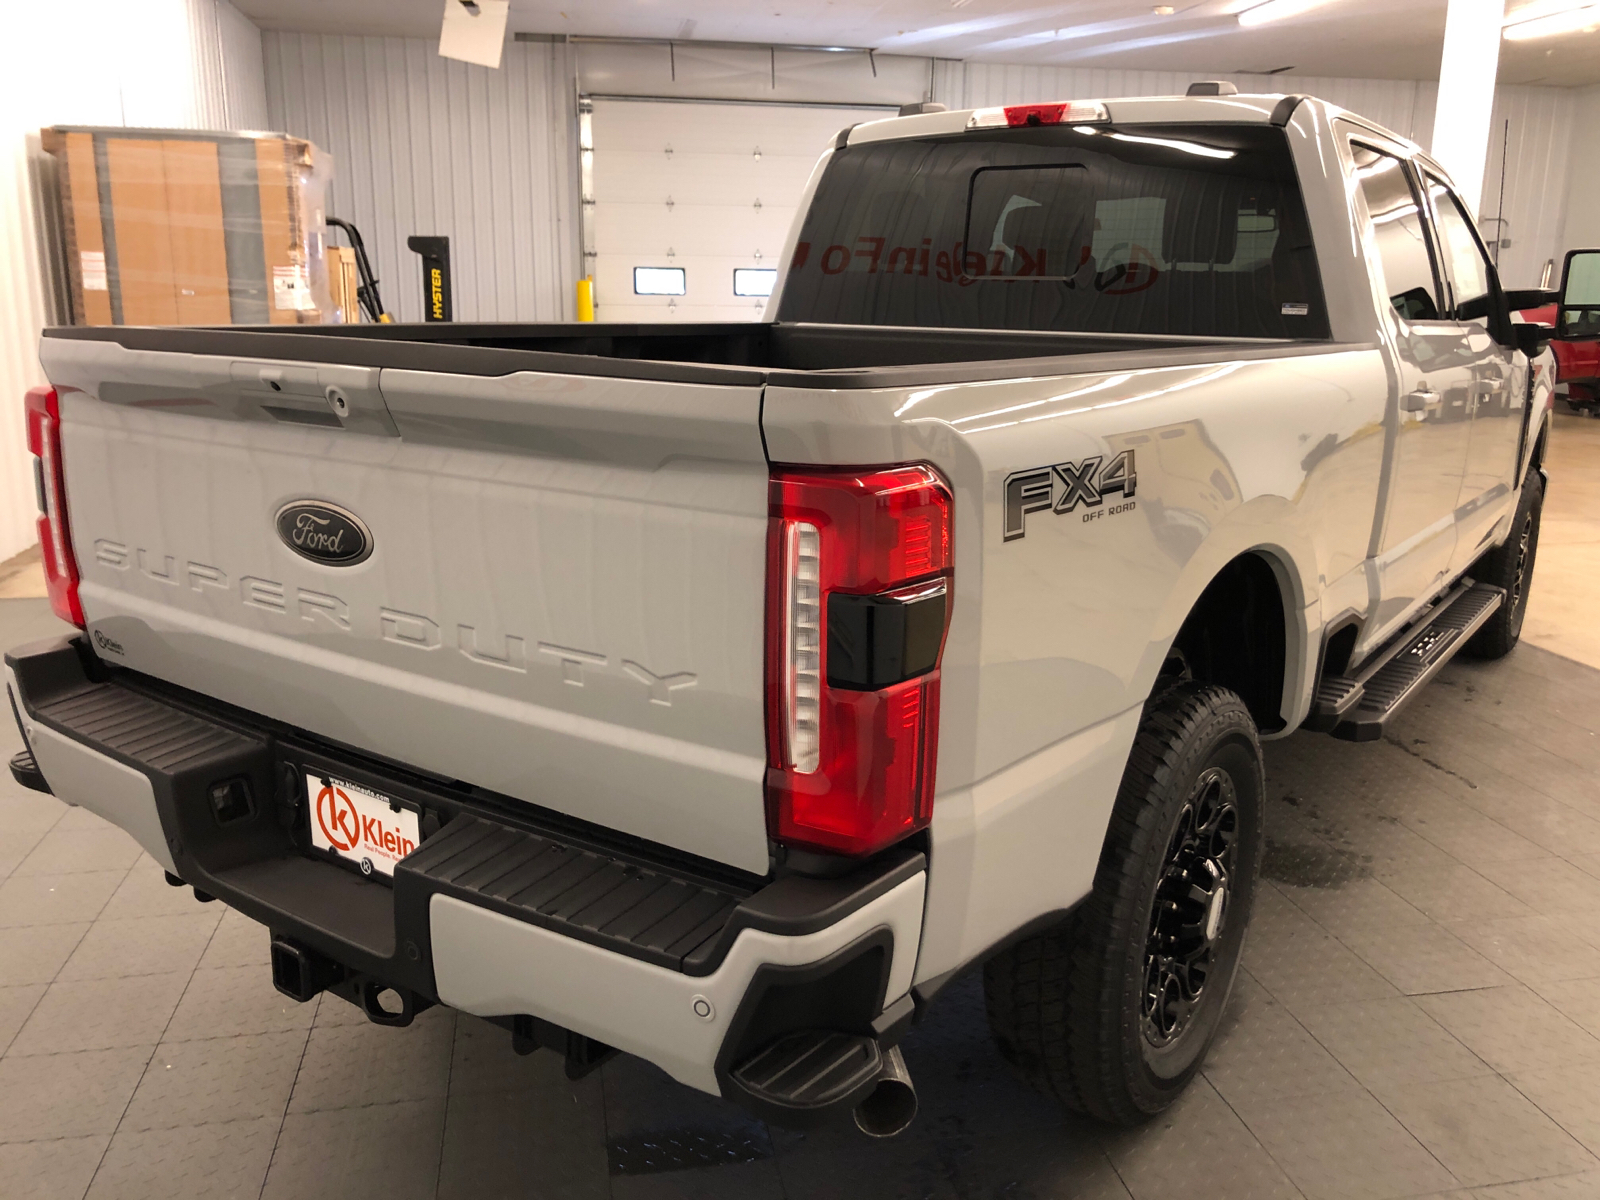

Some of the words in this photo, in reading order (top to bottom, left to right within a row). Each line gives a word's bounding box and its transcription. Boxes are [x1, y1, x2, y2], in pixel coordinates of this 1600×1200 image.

[431, 268, 443, 319] HYSTER
[1003, 449, 1137, 543] FX4
[1082, 510, 1104, 523] OFF
[1108, 501, 1136, 516] ROAD
[292, 513, 344, 553] Ford
[94, 538, 351, 631] SUPER
[380, 606, 698, 707] DUTY
[329, 777, 390, 803] www.kleinauto.com
[362, 814, 415, 857] Klein
